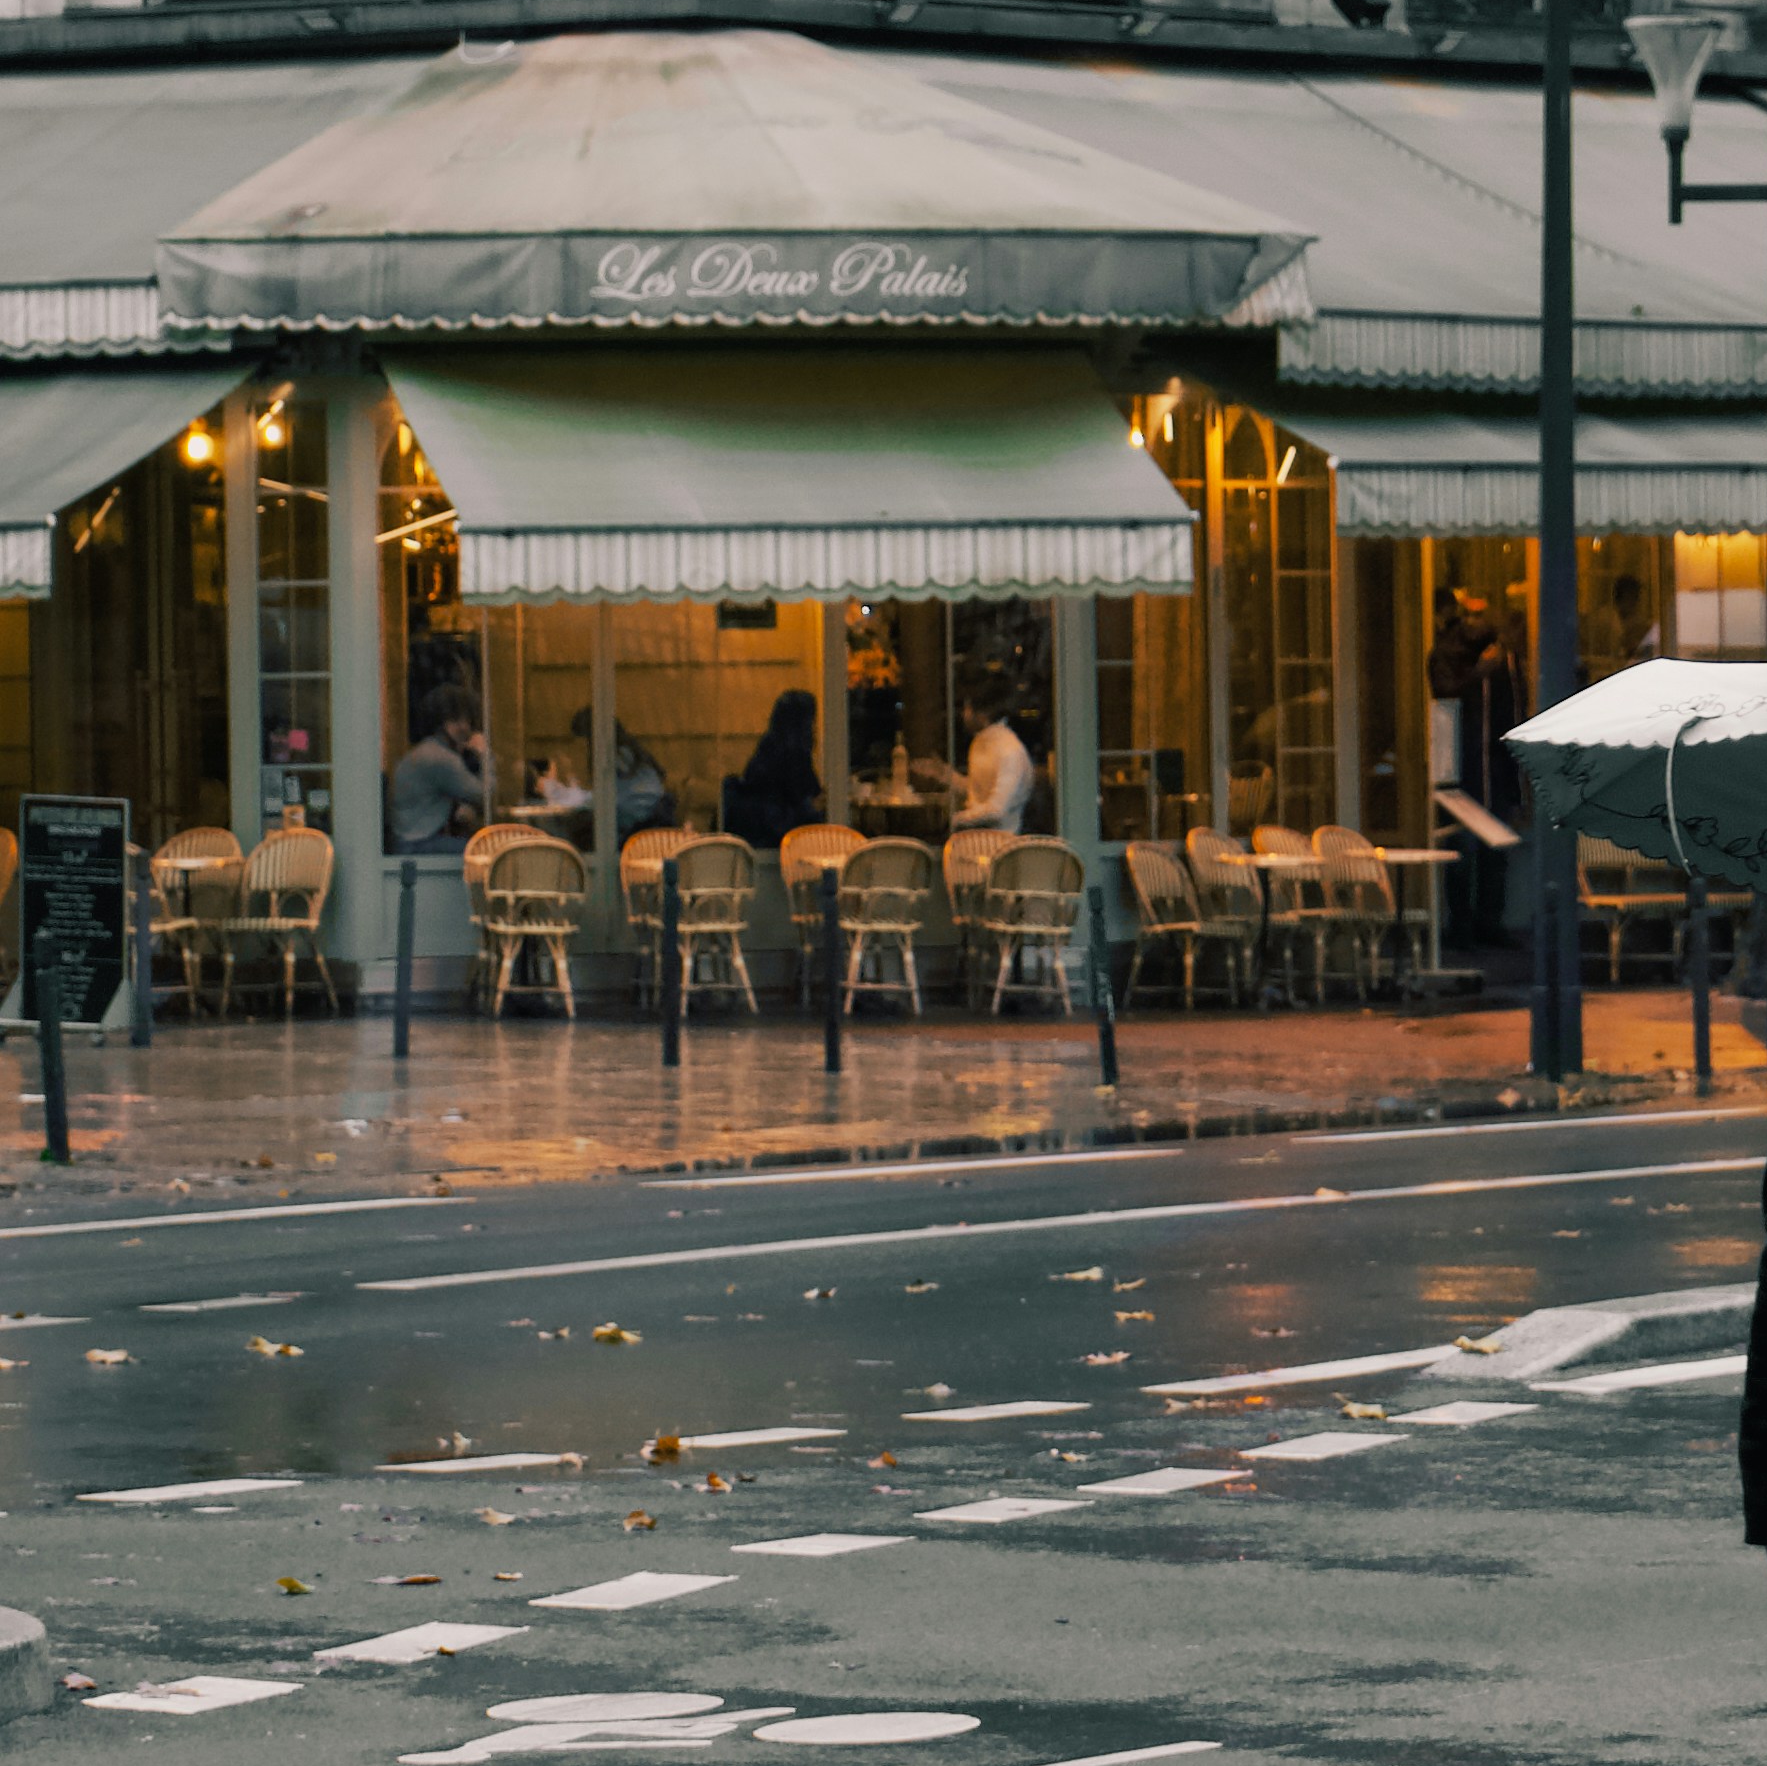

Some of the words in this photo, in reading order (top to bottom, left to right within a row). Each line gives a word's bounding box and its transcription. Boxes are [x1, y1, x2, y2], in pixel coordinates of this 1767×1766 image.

[589, 240, 678, 302] Les
[684, 240, 820, 298] Deux
[828, 240, 969, 298] Palais
